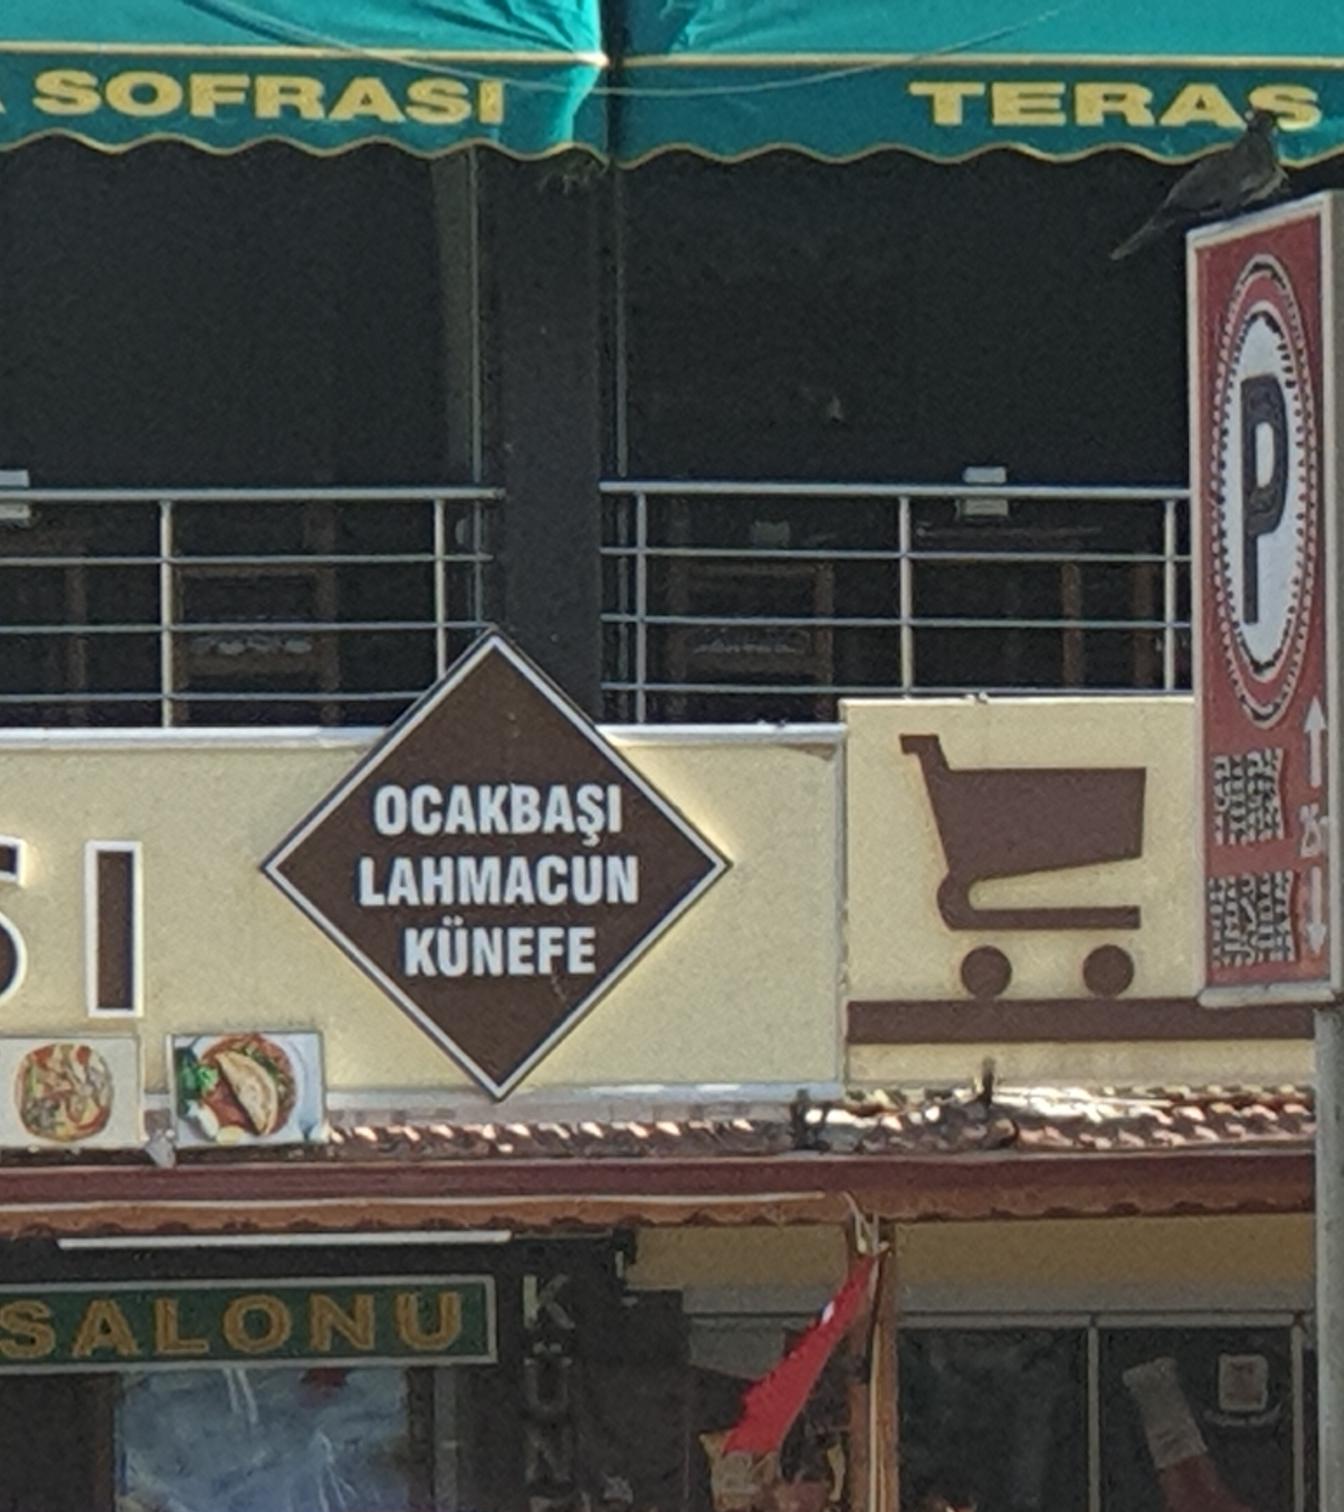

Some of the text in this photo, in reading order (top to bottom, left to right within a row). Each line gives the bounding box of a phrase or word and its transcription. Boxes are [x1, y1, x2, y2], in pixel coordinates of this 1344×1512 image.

[32, 69, 505, 125] SOFRASI
[909, 81, 1323, 132] TERAS
[1239, 373, 1290, 625] P
[374, 784, 622, 846] OCAKBAŞI
[359, 856, 639, 907] LAHMACUN
[404, 917, 596, 977] KÜNEFE
[0, 1288, 465, 1360] SALONU
